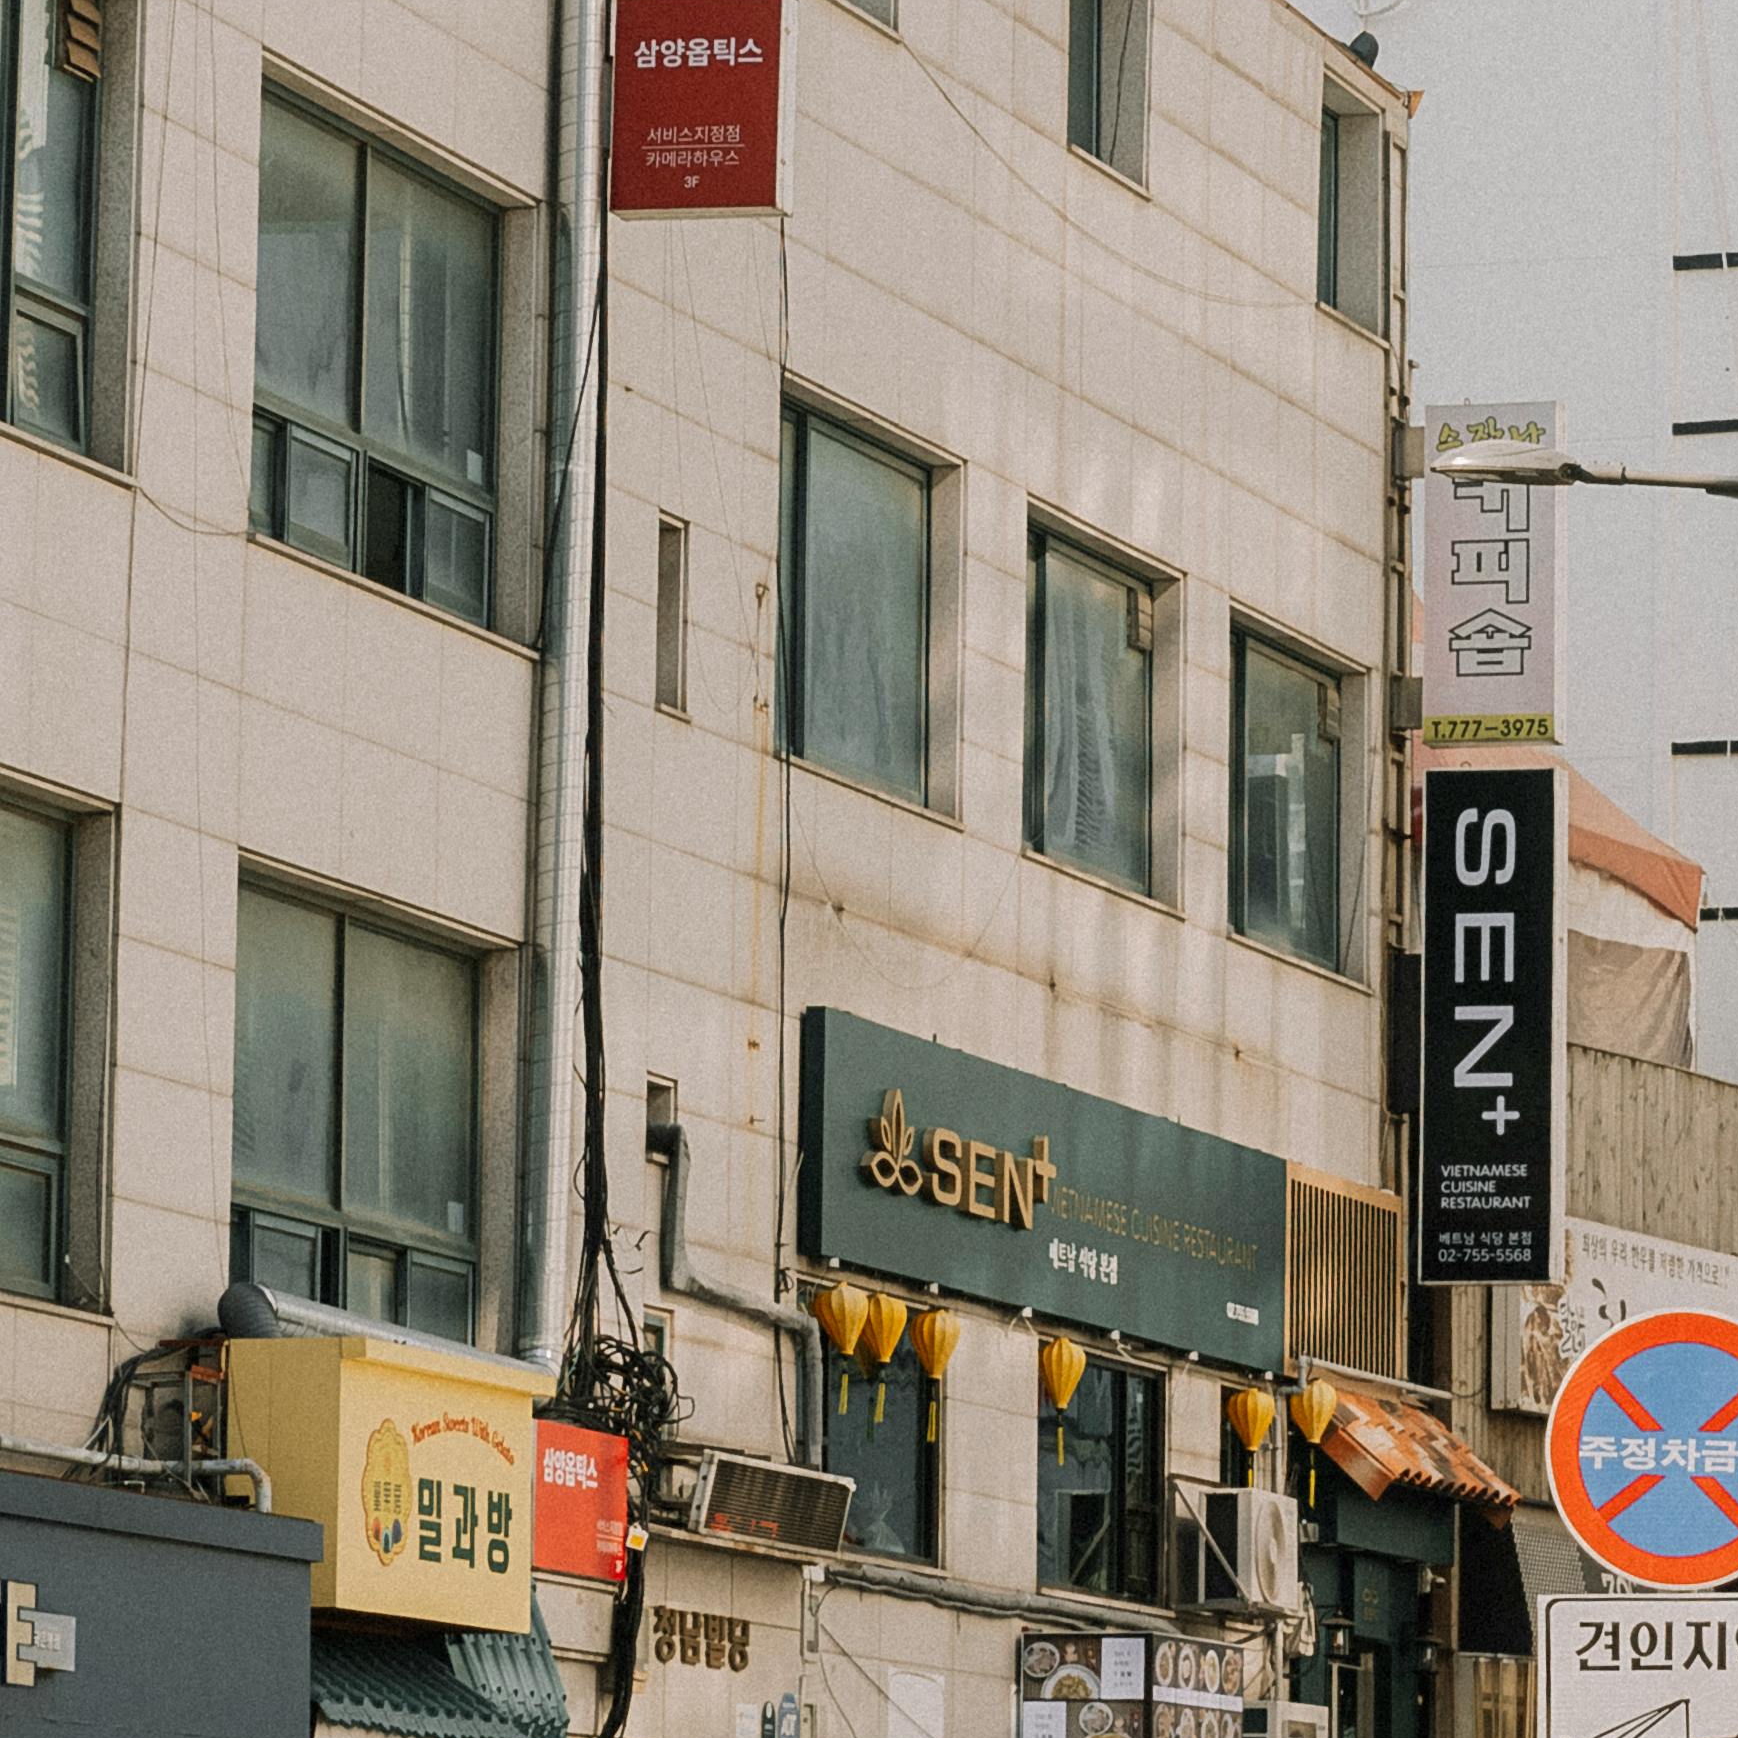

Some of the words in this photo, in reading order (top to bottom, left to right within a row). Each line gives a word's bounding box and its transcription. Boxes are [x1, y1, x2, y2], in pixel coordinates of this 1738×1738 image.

[634, 37, 763, 68] 삼양옵틱스
[647, 125, 741, 143] 서비스지정점
[646, 150, 739, 168] 카메라하우스
[684, 176, 700, 188] 3F
[1431, 719, 1549, 740] T.777-3975
[1441, 1164, 1528, 1177] VIETNAMESE
[1441, 1180, 1496, 1193] CUISINE
[1441, 1196, 1531, 1209] RESTAURANT
[1480, 1231, 1503, 1245] 식당
[1508, 1231, 1532, 1245] 본점
[1049, 1238, 1076, 1273] 베트남
[1438, 1248, 1532, 1262] 02-755-5568
[543, 1447, 598, 1490] 삼양옵틱스
[418, 1477, 512, 1574] 밀과방
[653, 1605, 750, 1672] 정남빌딩
